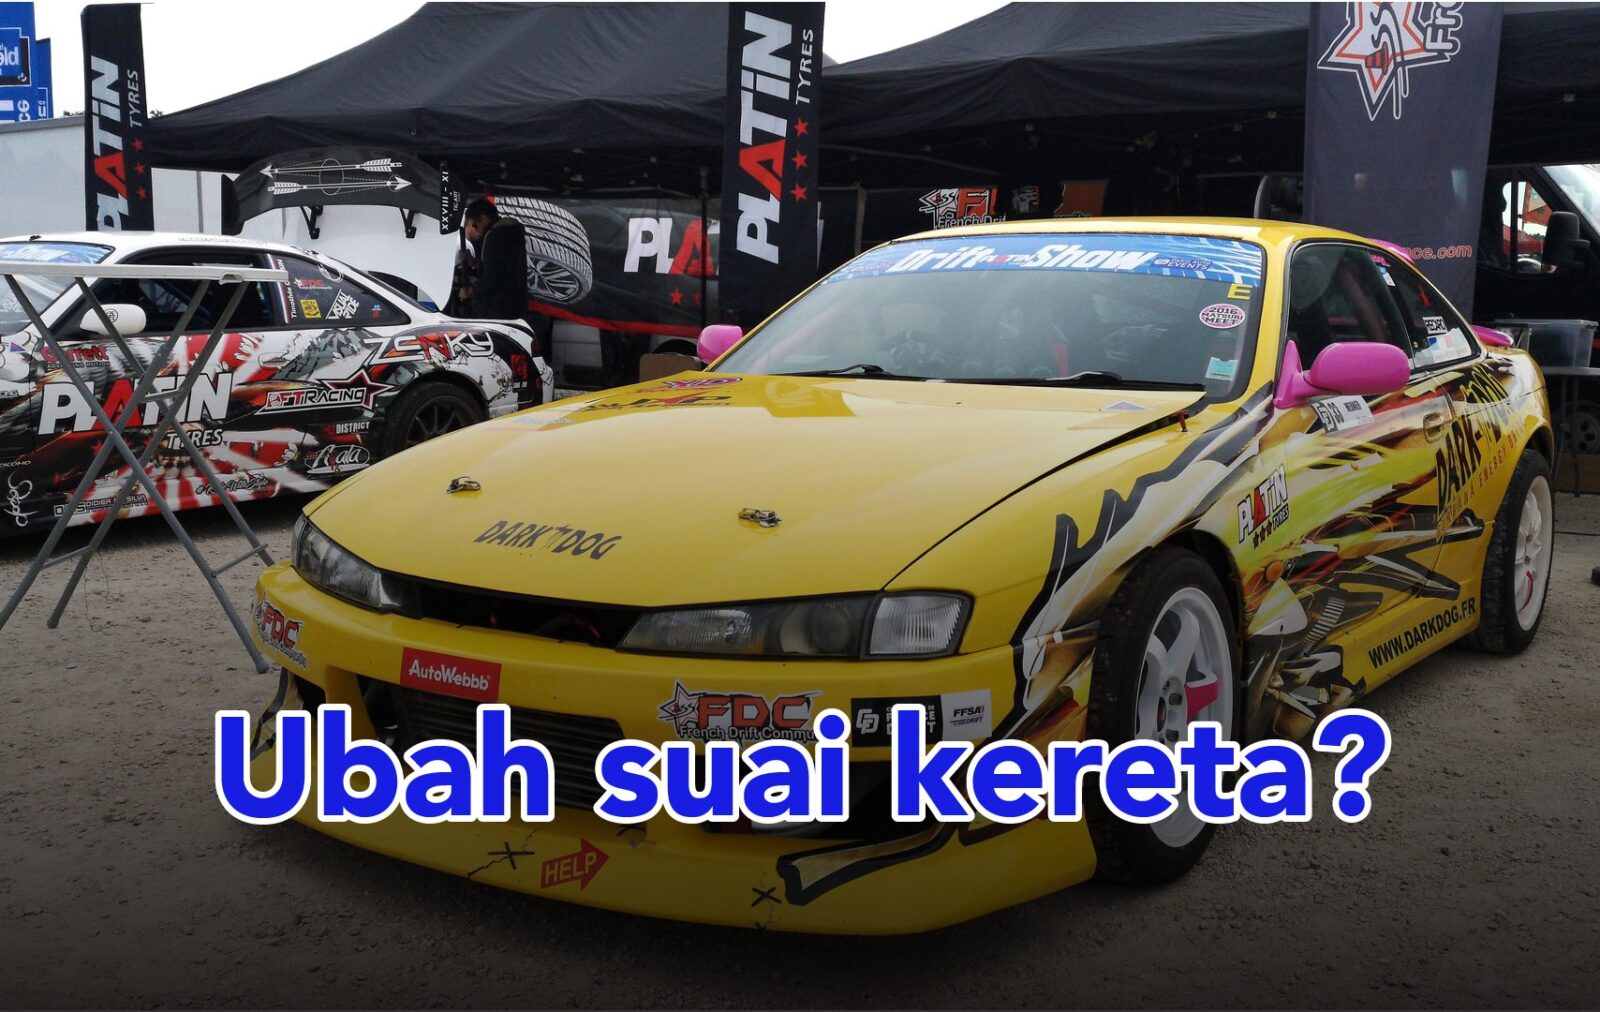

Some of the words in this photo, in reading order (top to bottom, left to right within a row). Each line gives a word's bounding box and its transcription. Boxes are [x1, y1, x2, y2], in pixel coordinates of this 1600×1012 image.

[795, 28, 814, 105] TYRES
[127, 69, 140, 129] TYRES
[1021, 244, 1160, 270] Show
[1226, 283, 1253, 300] E
[1209, 306, 1238, 315] 2016
[335, 421, 370, 435] DISTRICT
[474, 520, 552, 548] DARK
[551, 529, 623, 561] DOG
[261, 605, 300, 650] FDC
[1368, 597, 1476, 669] WWW.DARKDOG.FR
[407, 658, 490, 692] AutoWebbb
[697, 693, 813, 730] FDC
[953, 706, 981, 717] FFSA
[680, 725, 726, 741] French
[728, 725, 760, 740] Drift
[544, 851, 598, 886] HELP
